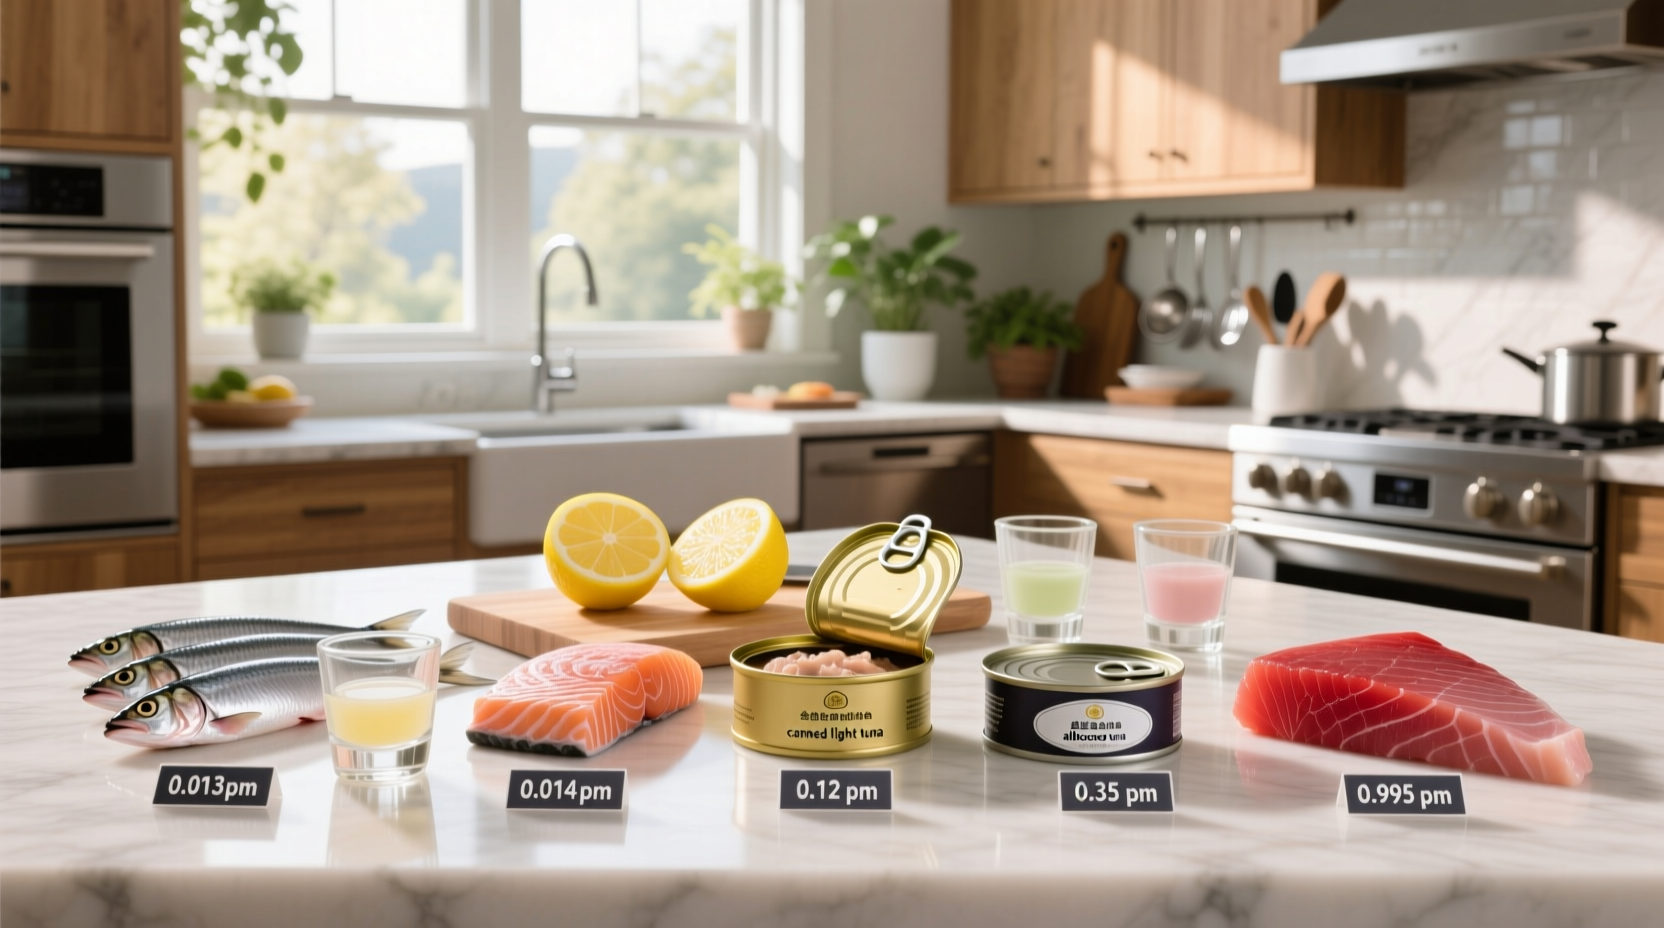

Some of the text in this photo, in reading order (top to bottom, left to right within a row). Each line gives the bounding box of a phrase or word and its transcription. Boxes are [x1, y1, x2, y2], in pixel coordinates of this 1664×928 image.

[796, 779, 878, 806] 0.12 pm
[1074, 781, 1158, 808] 0.35 pm
[1357, 783, 1453, 810] 0.995 pm
